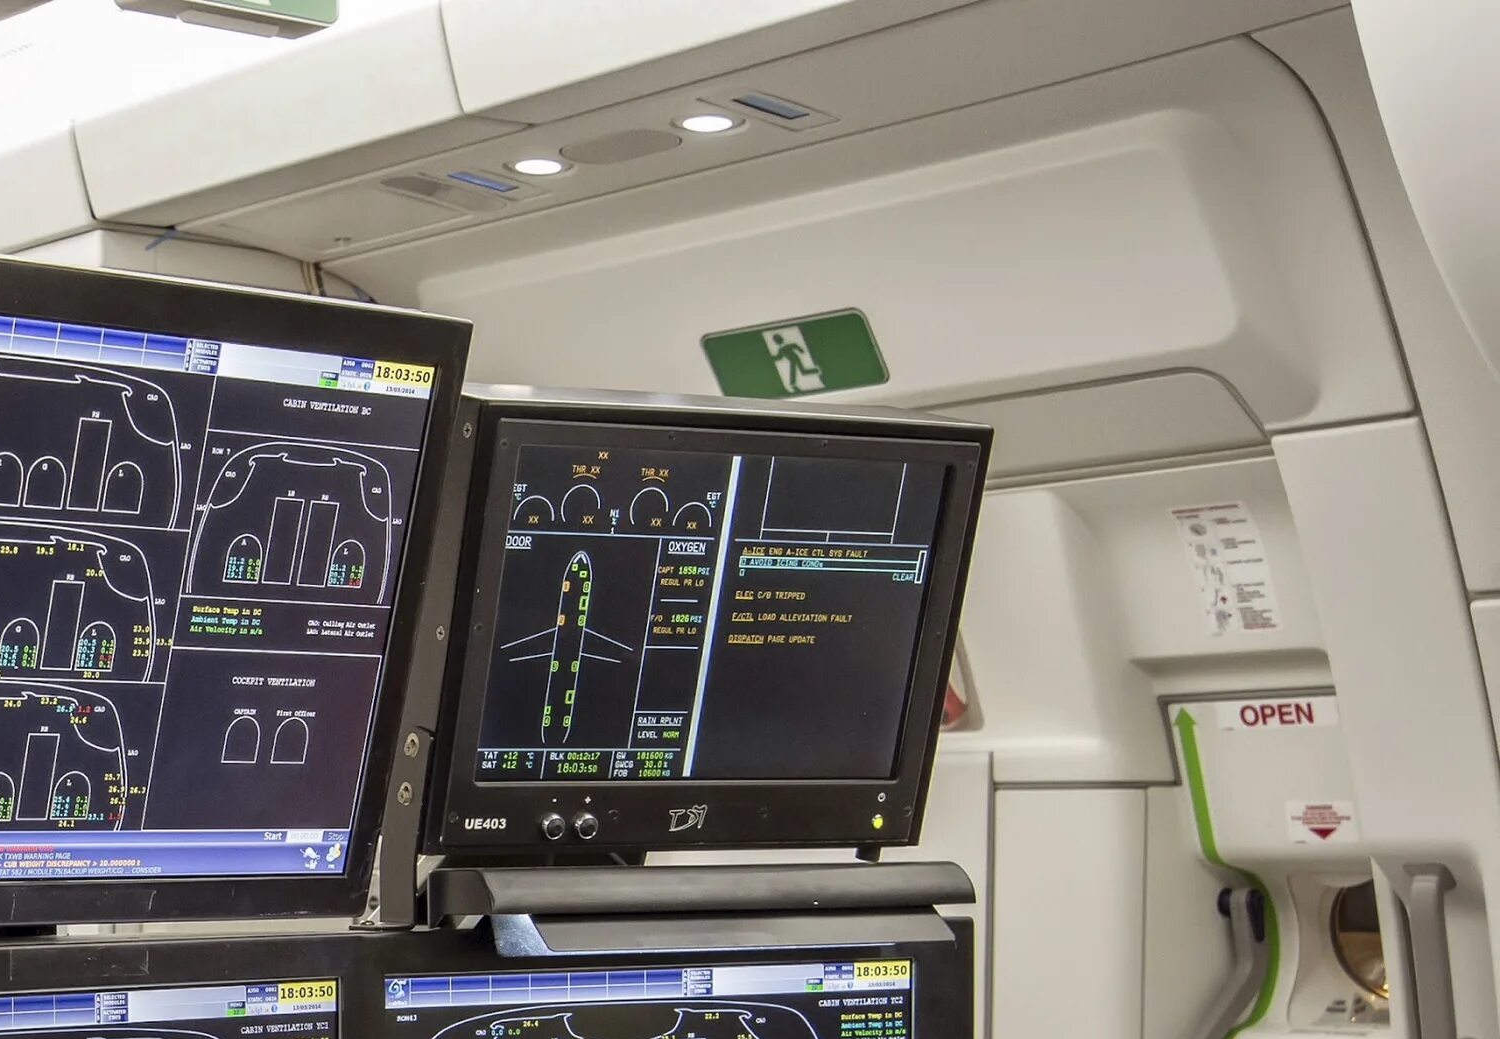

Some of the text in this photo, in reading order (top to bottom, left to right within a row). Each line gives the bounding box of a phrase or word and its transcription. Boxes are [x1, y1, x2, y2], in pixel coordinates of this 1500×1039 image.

[376, 366, 430, 383] 18:03:50
[283, 398, 306, 408] CABIN
[310, 401, 358, 414] VENTILATION
[572, 465, 587, 474] THR
[642, 468, 655, 477] THR
[707, 492, 721, 500] EGT
[506, 536, 531, 547] DOOR
[668, 542, 706, 552] OXYGEN
[743, 547, 765, 556] A-ICE
[786, 548, 808, 556] A-ICE
[812, 549, 826, 557] CTL
[845, 550, 867, 558] FAULT
[750, 559, 772, 567] AVOID
[893, 573, 914, 581] CLEAR
[735, 591, 805, 600] ELEC C/B TRIPPED
[758, 614, 776, 622] LOAD
[779, 614, 827, 623] ALLEVIATION
[830, 614, 852, 622] FAULT
[728, 635, 815, 645] DISPATCH PAGE UPDATE
[232, 677, 315, 687] COCKPIT VENTILATION
[1240, 703, 1314, 726] OPEN
[638, 731, 679, 739] LEVEL NORM
[550, 752, 600, 760] BLK 00:12:17
[558, 763, 598, 774] 18:03:50
[464, 818, 506, 830] UE403
[264, 831, 281, 841] Start
[856, 965, 907, 977] 18:03:50
[280, 986, 333, 999] 18:03:50
[819, 997, 888, 1007] CABIN VENTILATION
[241, 1026, 263, 1035] CABIN
[266, 1023, 313, 1033] VENTILATION
